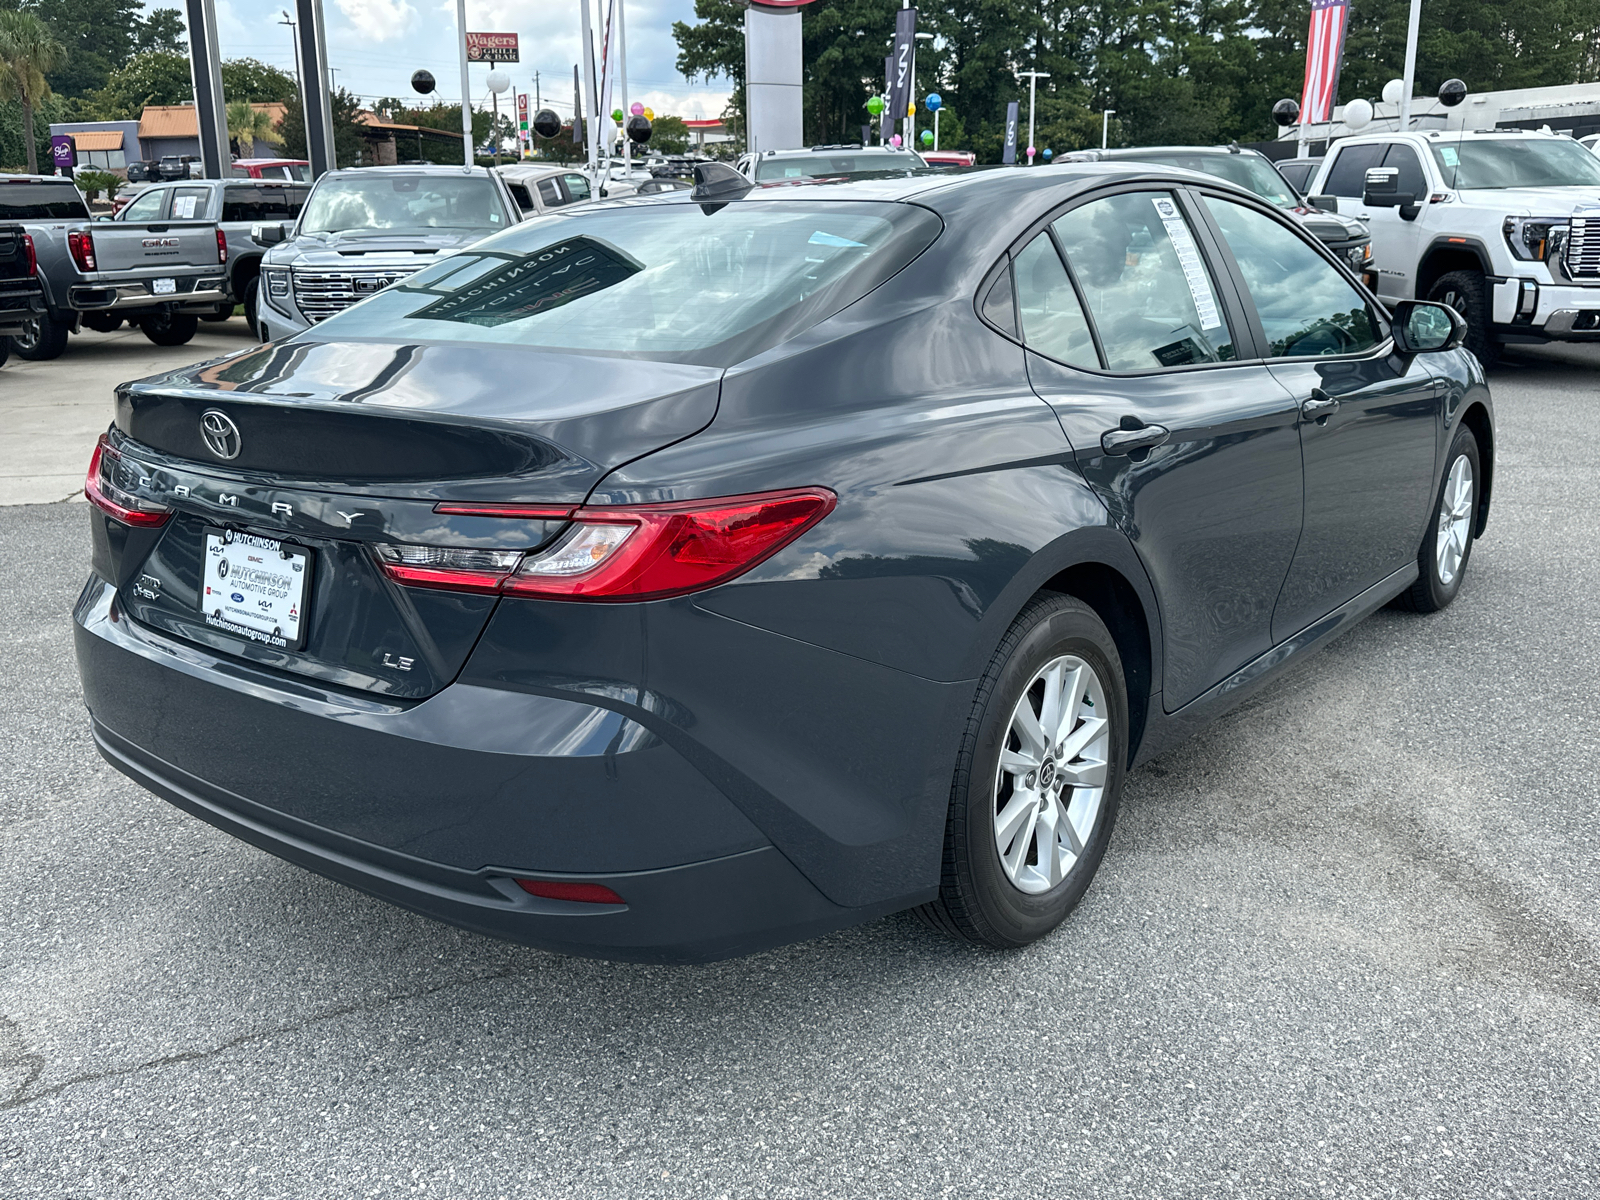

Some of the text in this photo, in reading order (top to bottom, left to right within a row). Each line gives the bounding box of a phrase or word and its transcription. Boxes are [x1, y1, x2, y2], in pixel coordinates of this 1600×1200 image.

[466, 33, 516, 48] Wagers
[142, 237, 180, 249] GMC
[139, 476, 365, 524] CAMRY
[233, 531, 281, 552] HUTCHINSON
[247, 555, 263, 564] GMC
[230, 564, 292, 589] HUTCHINSON
[230, 579, 288, 599] AUTOMOTIVE GROUP
[206, 613, 287, 647] Hutchinsonautogroup.com
[381, 653, 415, 671] LE
